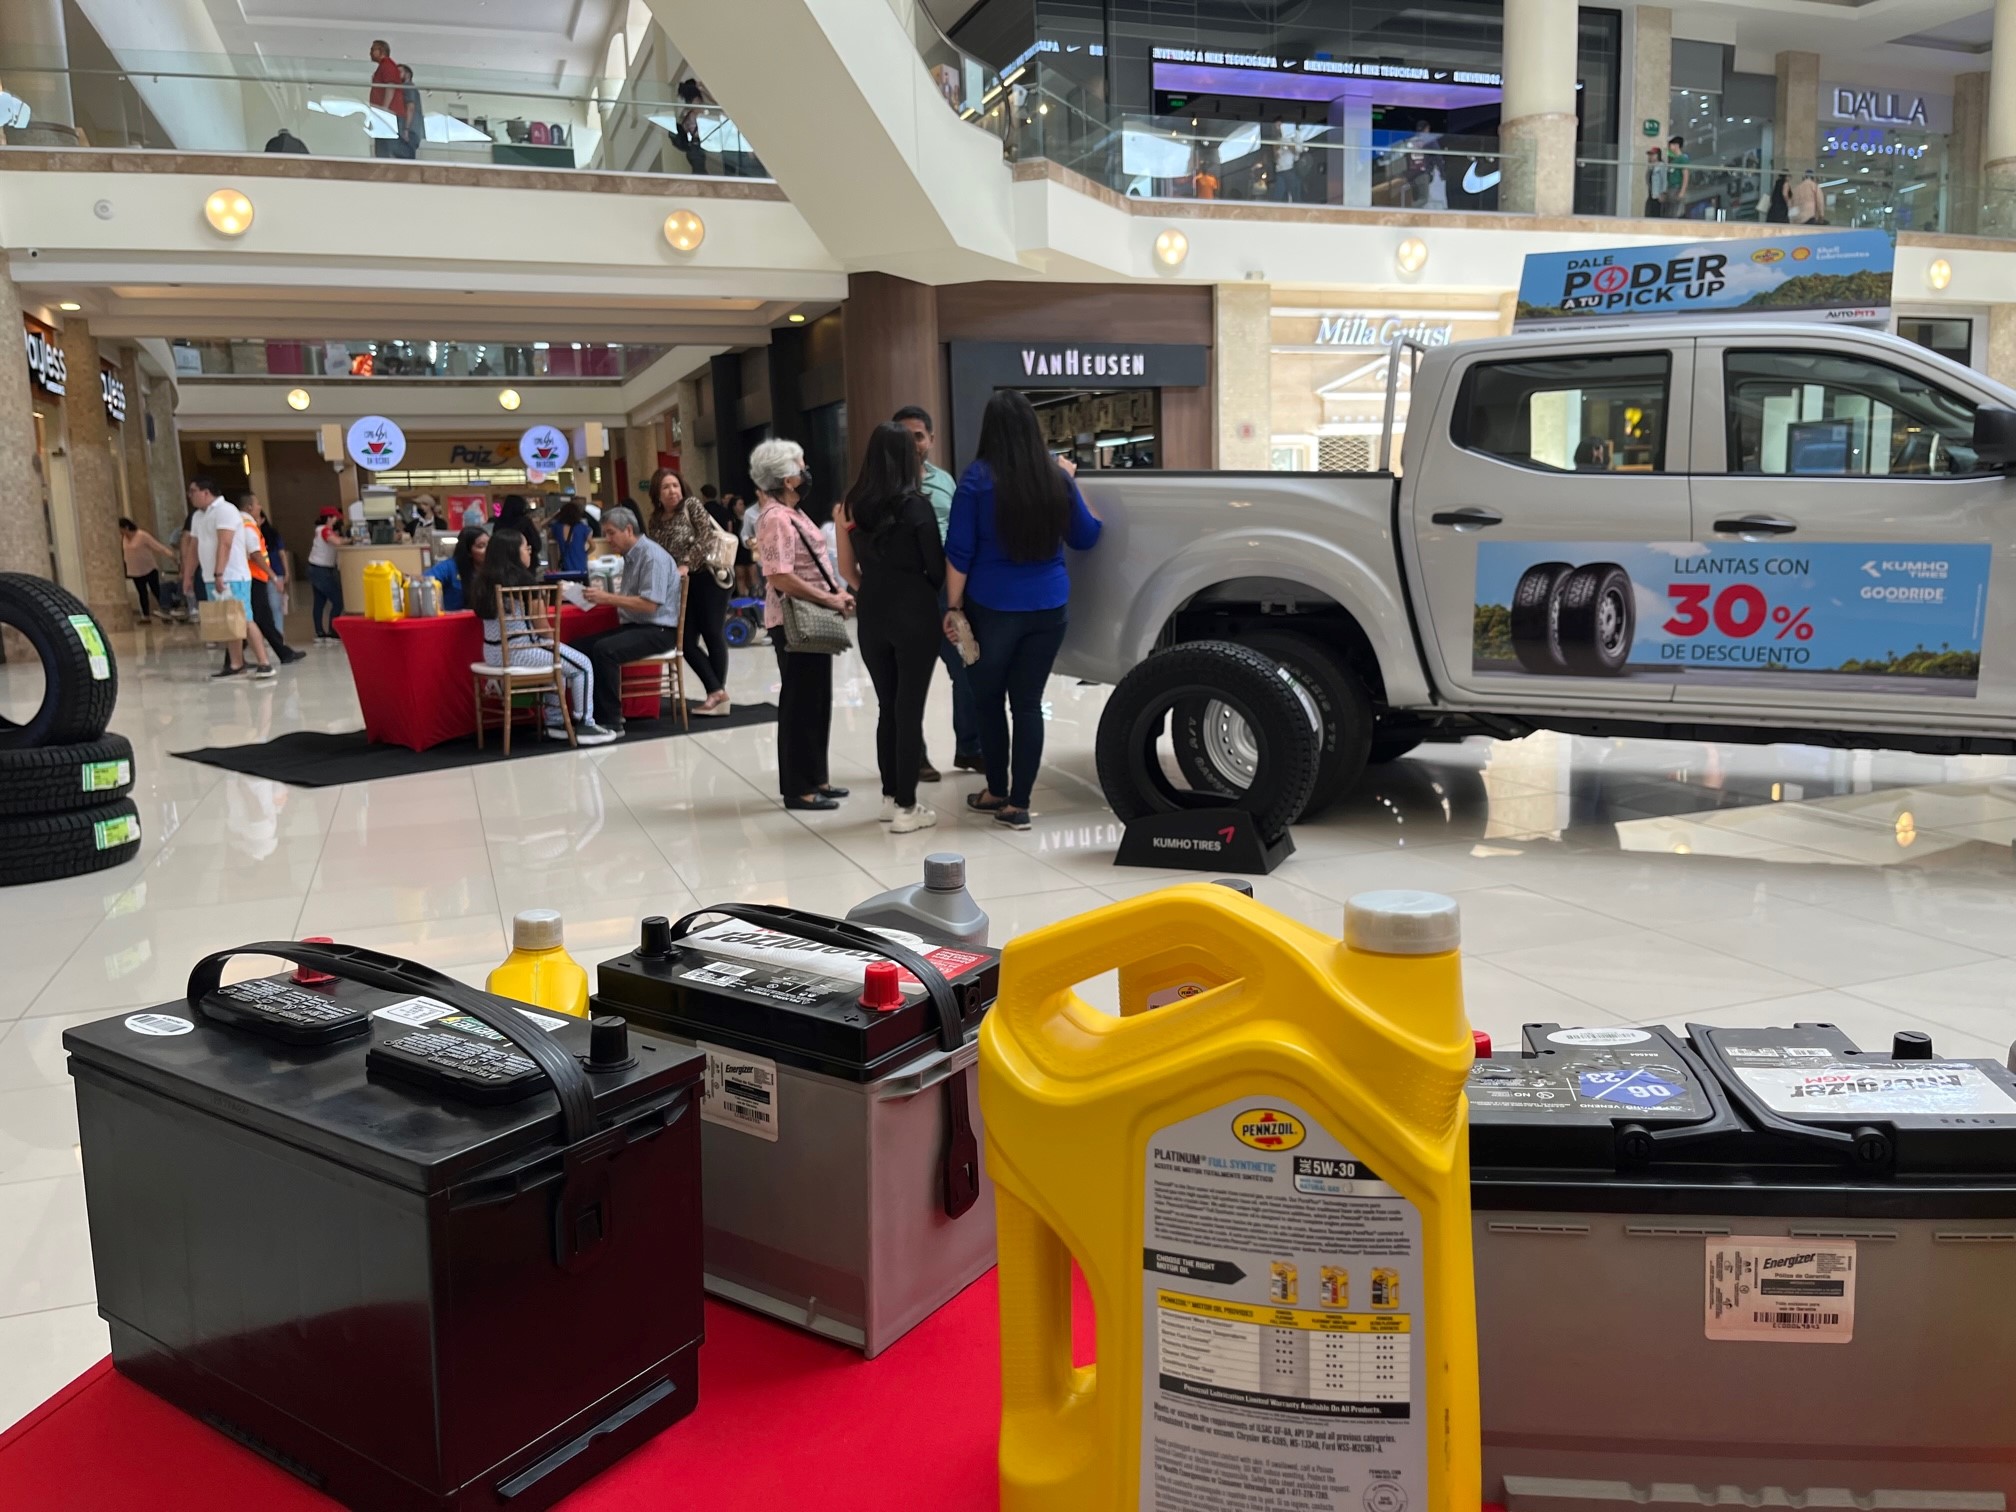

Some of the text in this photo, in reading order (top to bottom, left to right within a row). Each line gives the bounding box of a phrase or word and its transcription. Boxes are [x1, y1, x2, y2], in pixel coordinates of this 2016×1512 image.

[1567, 255, 1614, 270] DALE
[1563, 254, 1728, 297] PODER
[1563, 295, 1599, 309] A TU
[1606, 280, 1725, 309] PICK UP
[1315, 316, 1376, 345] Milla
[451, 445, 492, 465] Paiz
[1674, 558, 1810, 575] LLANTAS CON
[1882, 561, 1949, 571] KUMHO
[1909, 571, 1948, 579] TIRES
[1860, 586, 1944, 600] GOODRIDE
[1662, 644, 1810, 664] DE DESCUENTO
[1153, 837, 1221, 851] KUMHO TIRES
[725, 1064, 754, 1075] Energizer
[1586, 1072, 1621, 1084] 23
[1804, 1075, 1851, 1084] AGM
[1627, 1085, 1671, 1098] 06
[1242, 1122, 1294, 1137] PENNZOIL
[1208, 1157, 1228, 1169] FULL
[1230, 1159, 1277, 1173] SYNTHETIC
[1299, 1158, 1312, 1174] SAE
[1313, 1161, 1355, 1177] 5W-30
[1156, 1253, 1215, 1271] CHOOSE THE RIGHT
[1156, 1261, 1190, 1274] MOTOR OIL
[1762, 1253, 1816, 1270] Energizer
[1270, 1398, 1300, 1410] Warranty
[1300, 1402, 1330, 1412] Available
[1330, 1404, 1340, 1412] On
[1341, 1405, 1350, 1413] All
[1351, 1405, 1382, 1414] Products.
[1256, 1423, 1273, 1434] ILSAC
[1294, 1428, 1305, 1438] API
[1306, 1429, 1314, 1439] SP
[1315, 1431, 1327, 1441] and
[1336, 1432, 1362, 1443] previous
[1363, 1433, 1396, 1444] categories.
[1322, 1441, 1336, 1452] Ford
